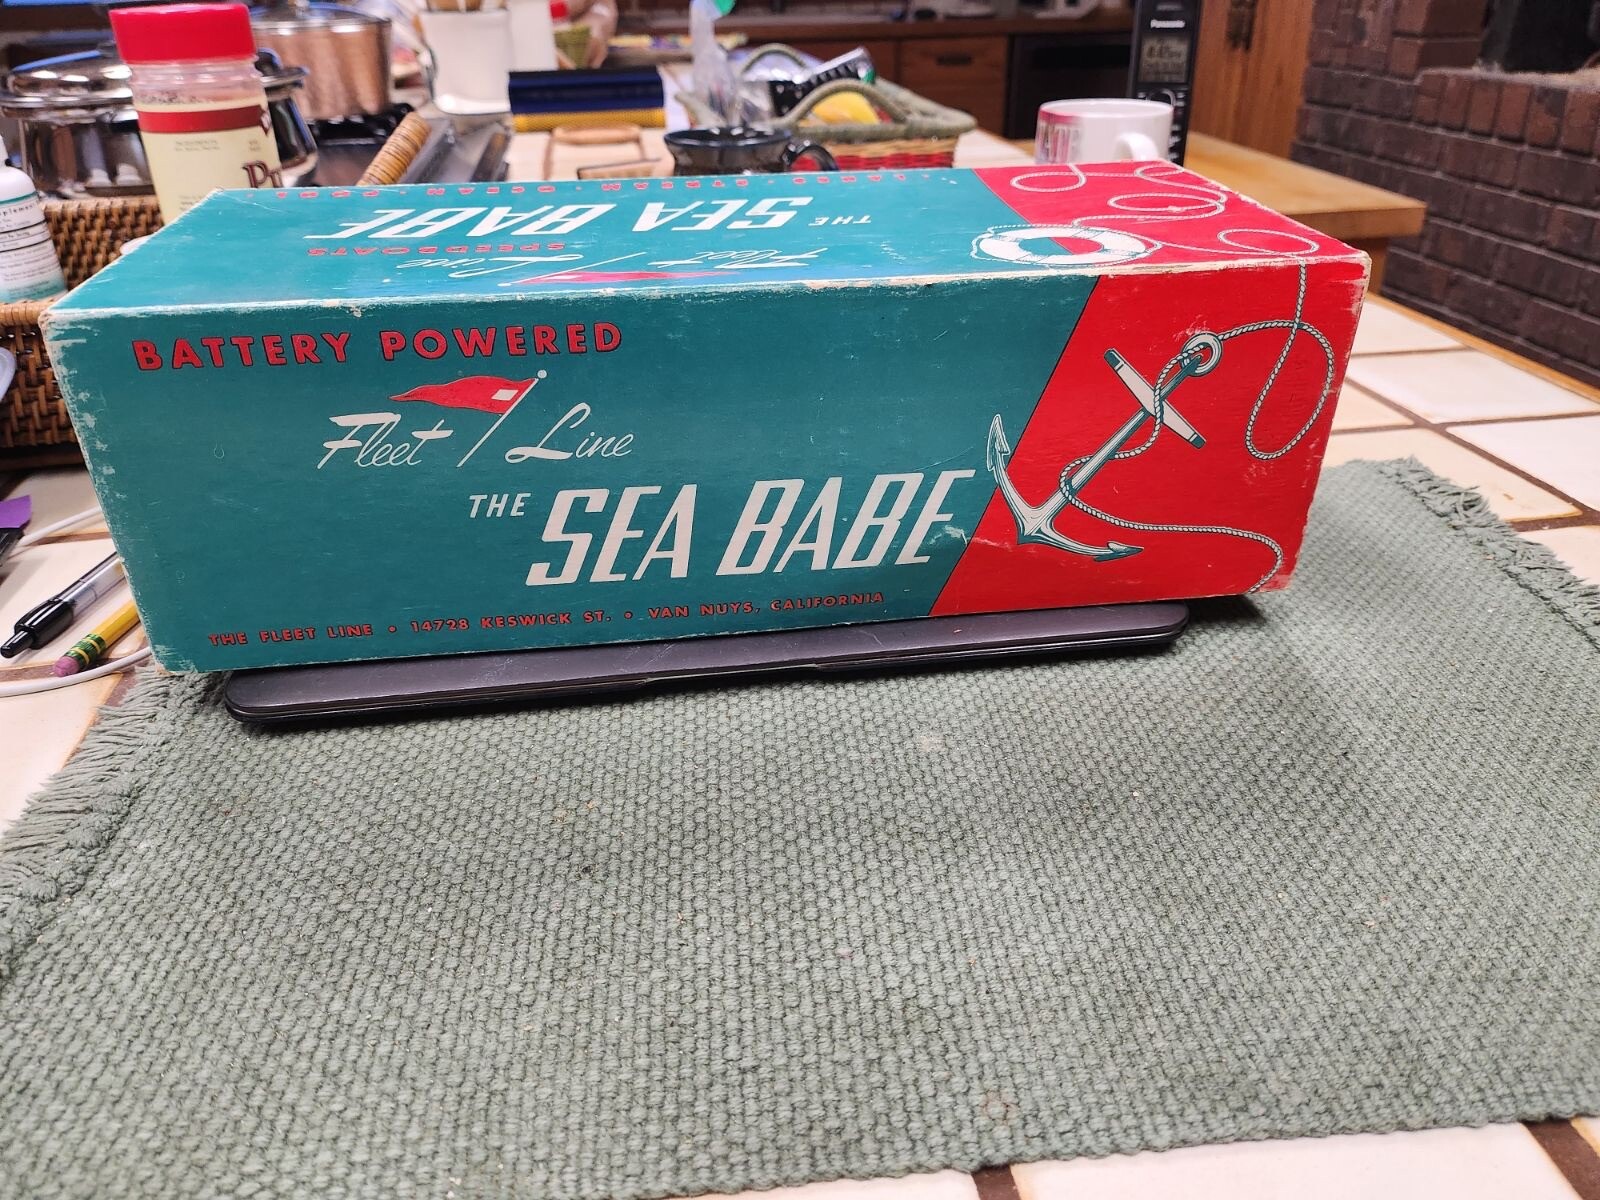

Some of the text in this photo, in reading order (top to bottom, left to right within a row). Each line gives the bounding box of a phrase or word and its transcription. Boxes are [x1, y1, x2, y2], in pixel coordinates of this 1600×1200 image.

[426, 184, 557, 196] OCEAN
[303, 196, 873, 240] THE SEA BABE
[307, 243, 567, 257] SPEEDBOATS
[395, 247, 828, 278] Fleet Line
[132, 322, 622, 371] BATTERY POWERED
[316, 402, 635, 470] Fleet Line
[469, 469, 976, 586] THE SEA BABE
[208, 592, 885, 647] THE FLEET LINE 14728 KESWICK ST. VAN NUYS, CALIFORNIA
